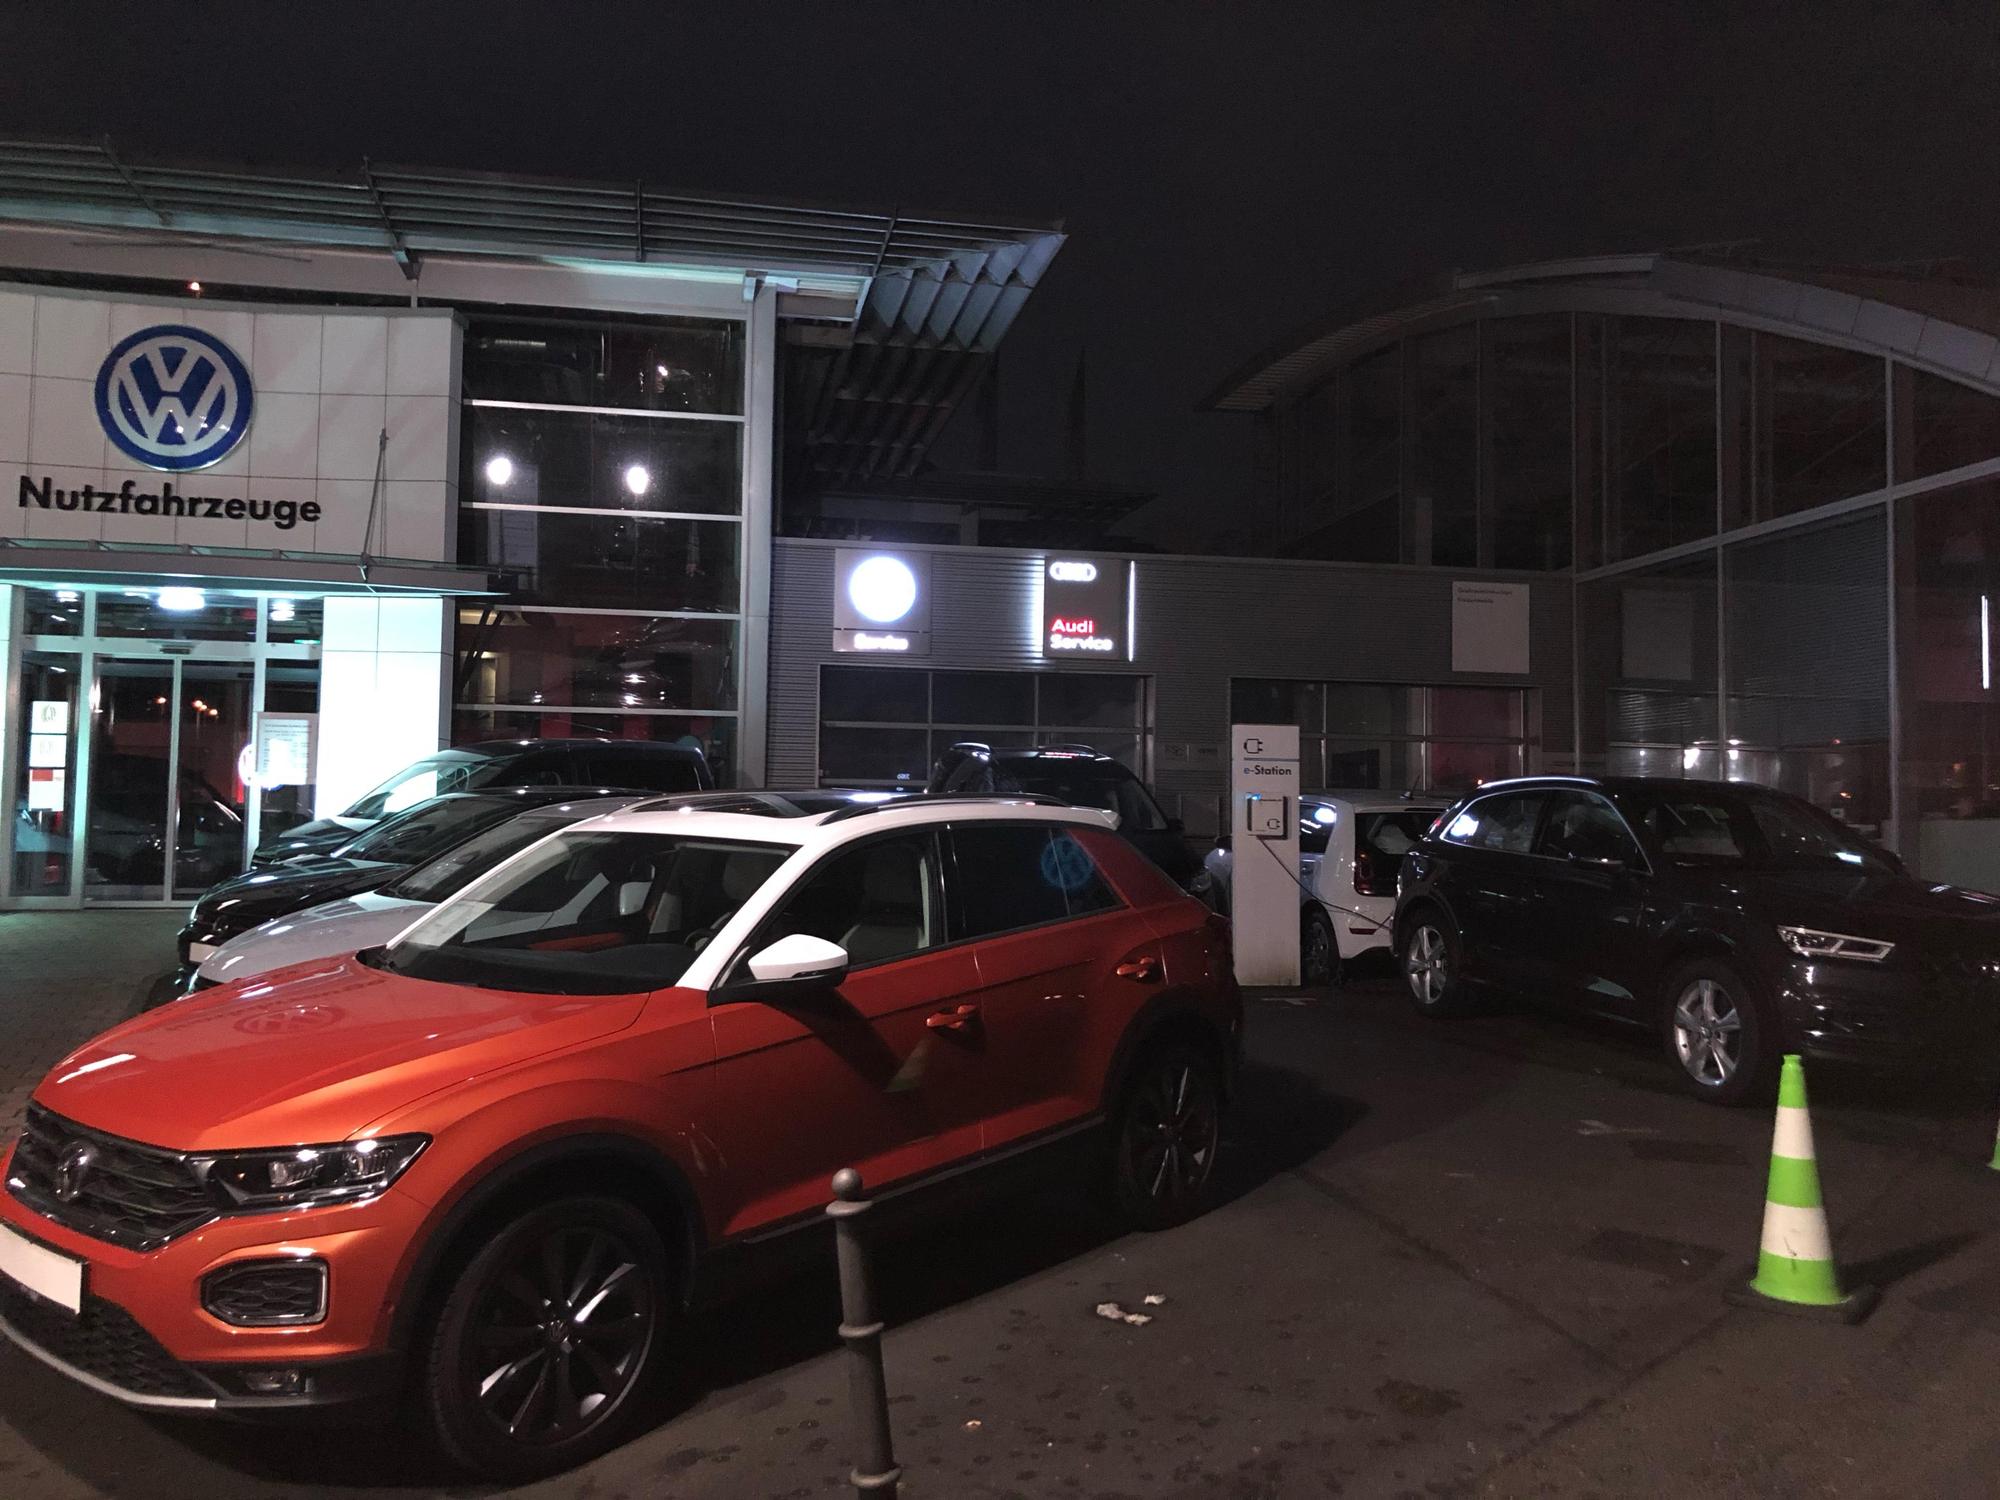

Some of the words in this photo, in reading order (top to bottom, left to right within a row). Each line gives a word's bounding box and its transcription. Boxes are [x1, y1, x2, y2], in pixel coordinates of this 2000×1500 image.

[105, 334, 240, 459] VW
[19, 475, 322, 530] Nutzfahrzeuge
[1051, 618, 1094, 634] Audi
[1243, 764, 1292, 776] e-Station
